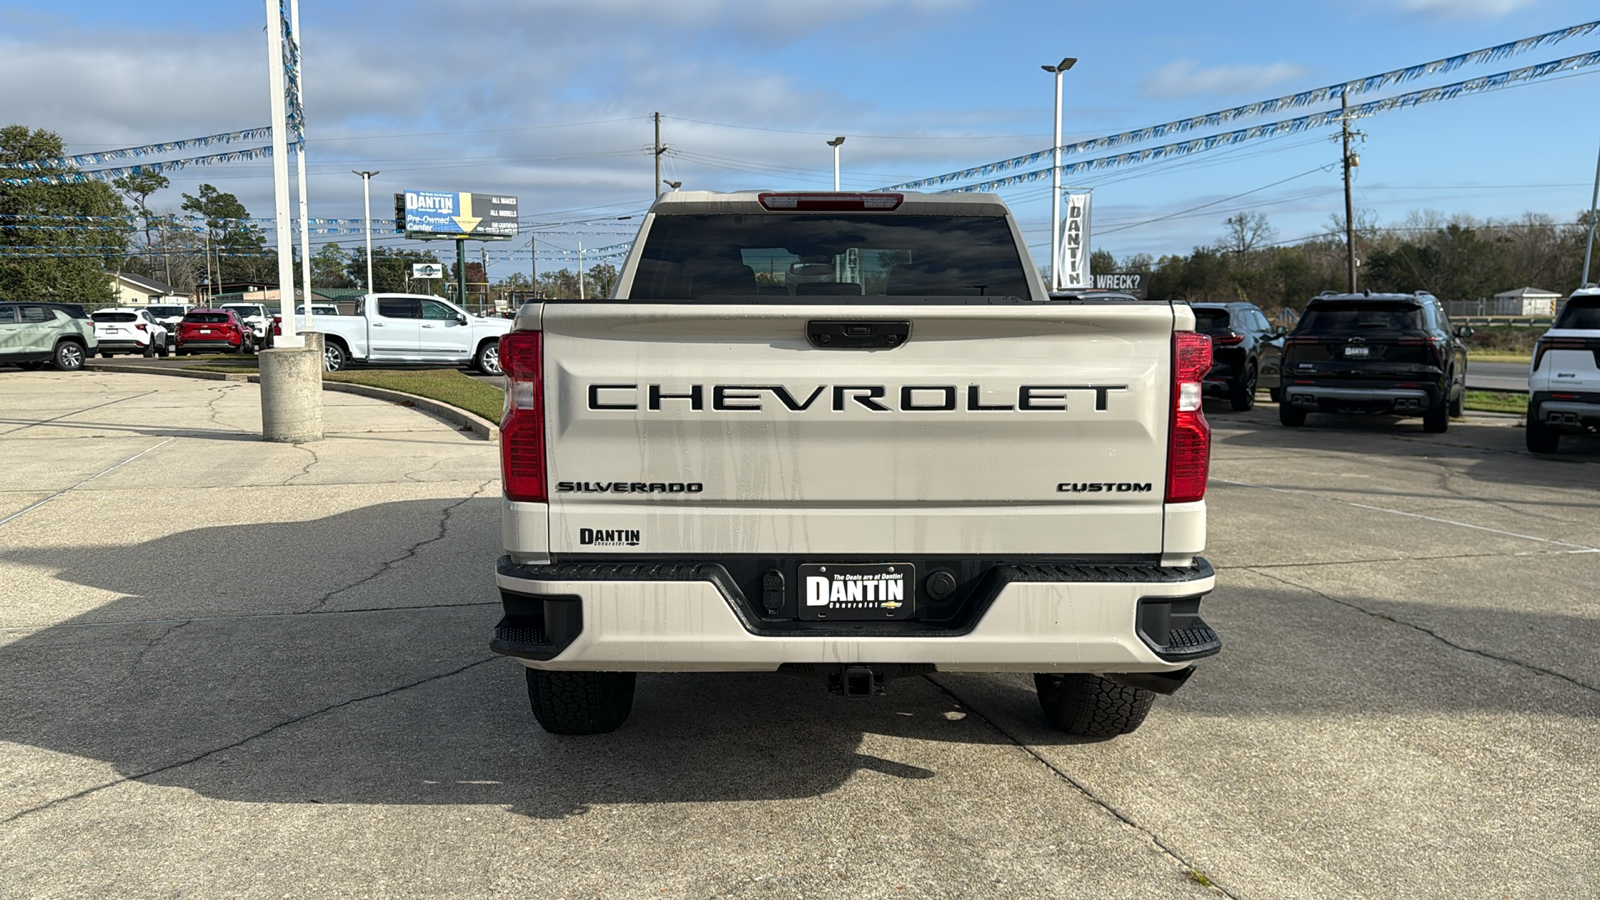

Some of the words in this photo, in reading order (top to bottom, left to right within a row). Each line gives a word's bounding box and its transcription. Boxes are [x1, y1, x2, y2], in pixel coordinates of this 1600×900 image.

[406, 193, 453, 209] DANTIN
[407, 215, 450, 224] Pre-Owned
[407, 223, 433, 231] Center
[1068, 206, 1081, 285] DANTIN
[1097, 274, 1141, 289] WRECK?
[588, 385, 1128, 411] CHEVROLET
[556, 482, 703, 493] SILVERADO
[1056, 483, 1152, 493] CUSTOM
[580, 528, 640, 545] DANTIN
[806, 576, 904, 606] DANTIN
